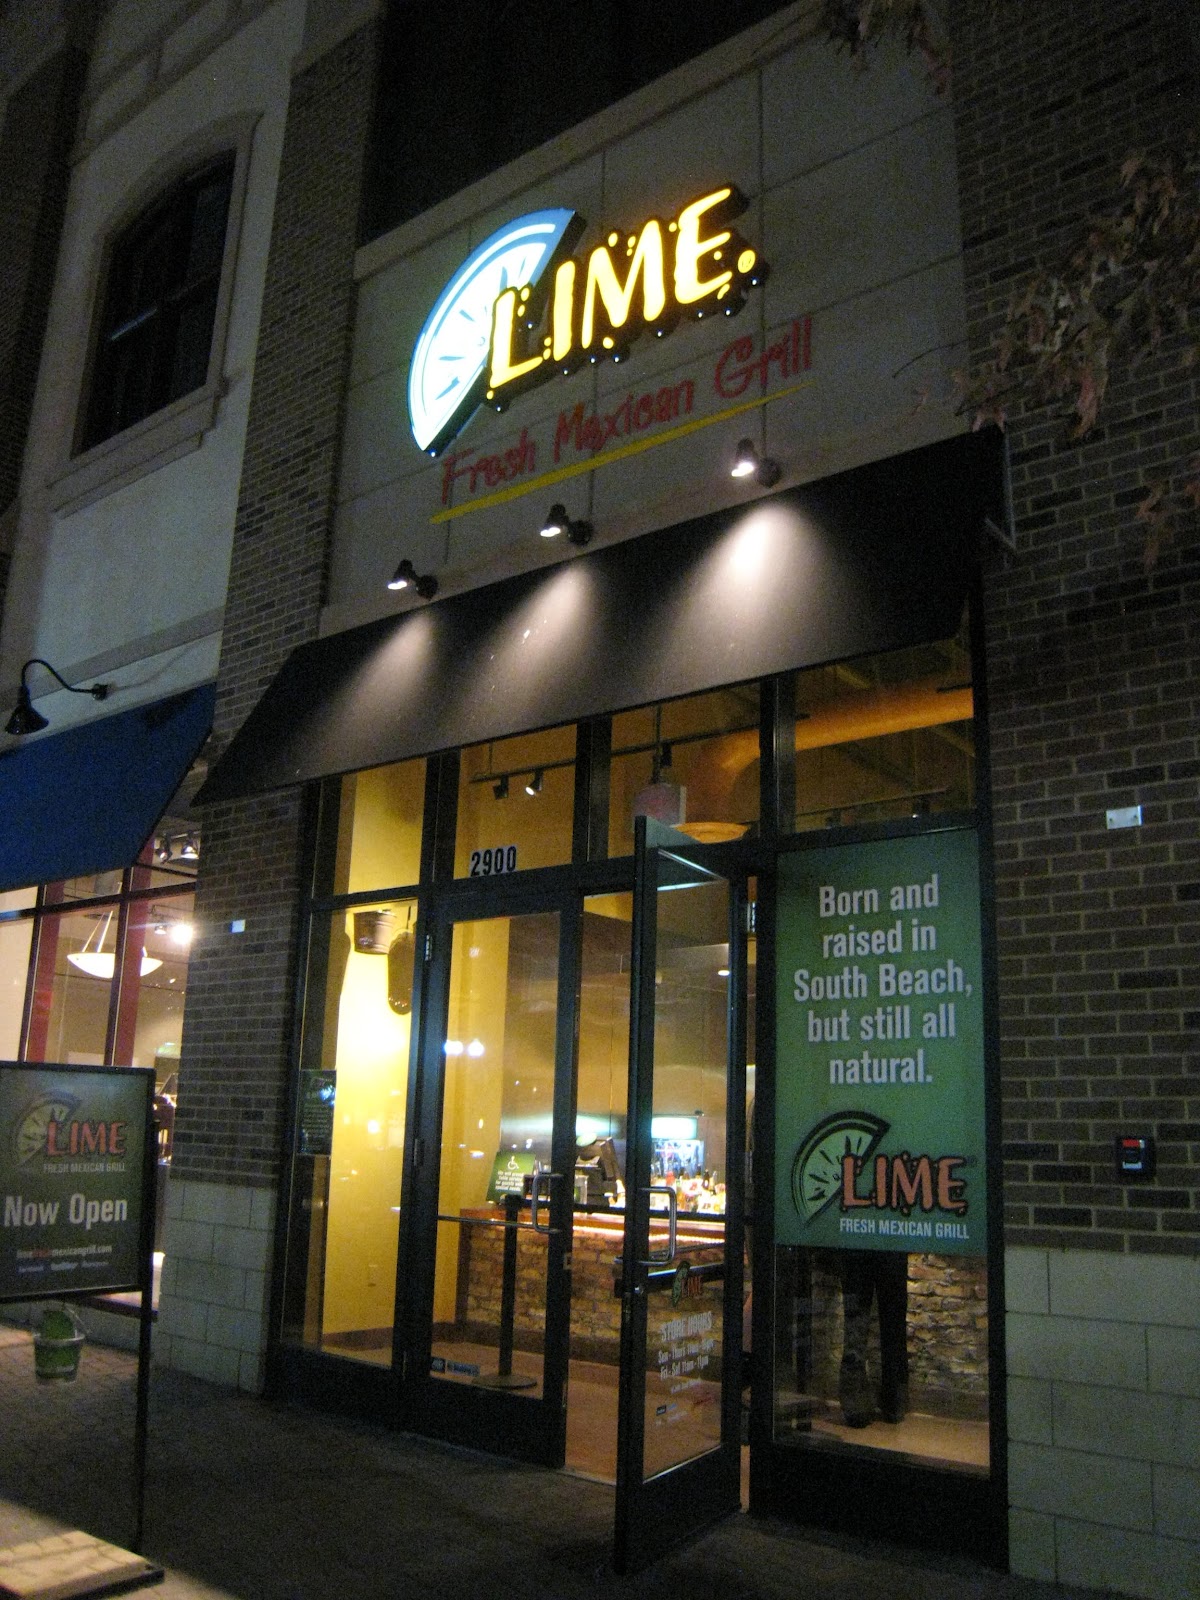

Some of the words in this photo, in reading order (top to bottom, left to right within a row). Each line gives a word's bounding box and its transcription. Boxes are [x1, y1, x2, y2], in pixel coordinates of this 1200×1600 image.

[488, 187, 734, 390] LIME
[442, 426, 537, 505] Fresh
[553, 379, 696, 464] Mexican
[714, 317, 812, 398] Grill
[470, 846, 517, 877] 2900
[818, 885, 879, 918] Born
[889, 873, 940, 911] and
[822, 920, 902, 960] raised
[911, 918, 937, 952] in
[793, 965, 868, 1003] South
[878, 958, 974, 999] Beach,
[807, 1009, 850, 1043] but
[859, 1005, 911, 1041] still
[922, 1003, 956, 1039] all
[829, 1048, 934, 1085] natural.
[46, 1119, 127, 1157] LIME
[842, 1154, 968, 1211] LIME
[4, 1195, 60, 1228] Now
[69, 1193, 128, 1230] Open
[839, 1217, 876, 1234] FRESH
[878, 1219, 932, 1238] MEXICAN
[935, 1222, 970, 1240] GRILL
